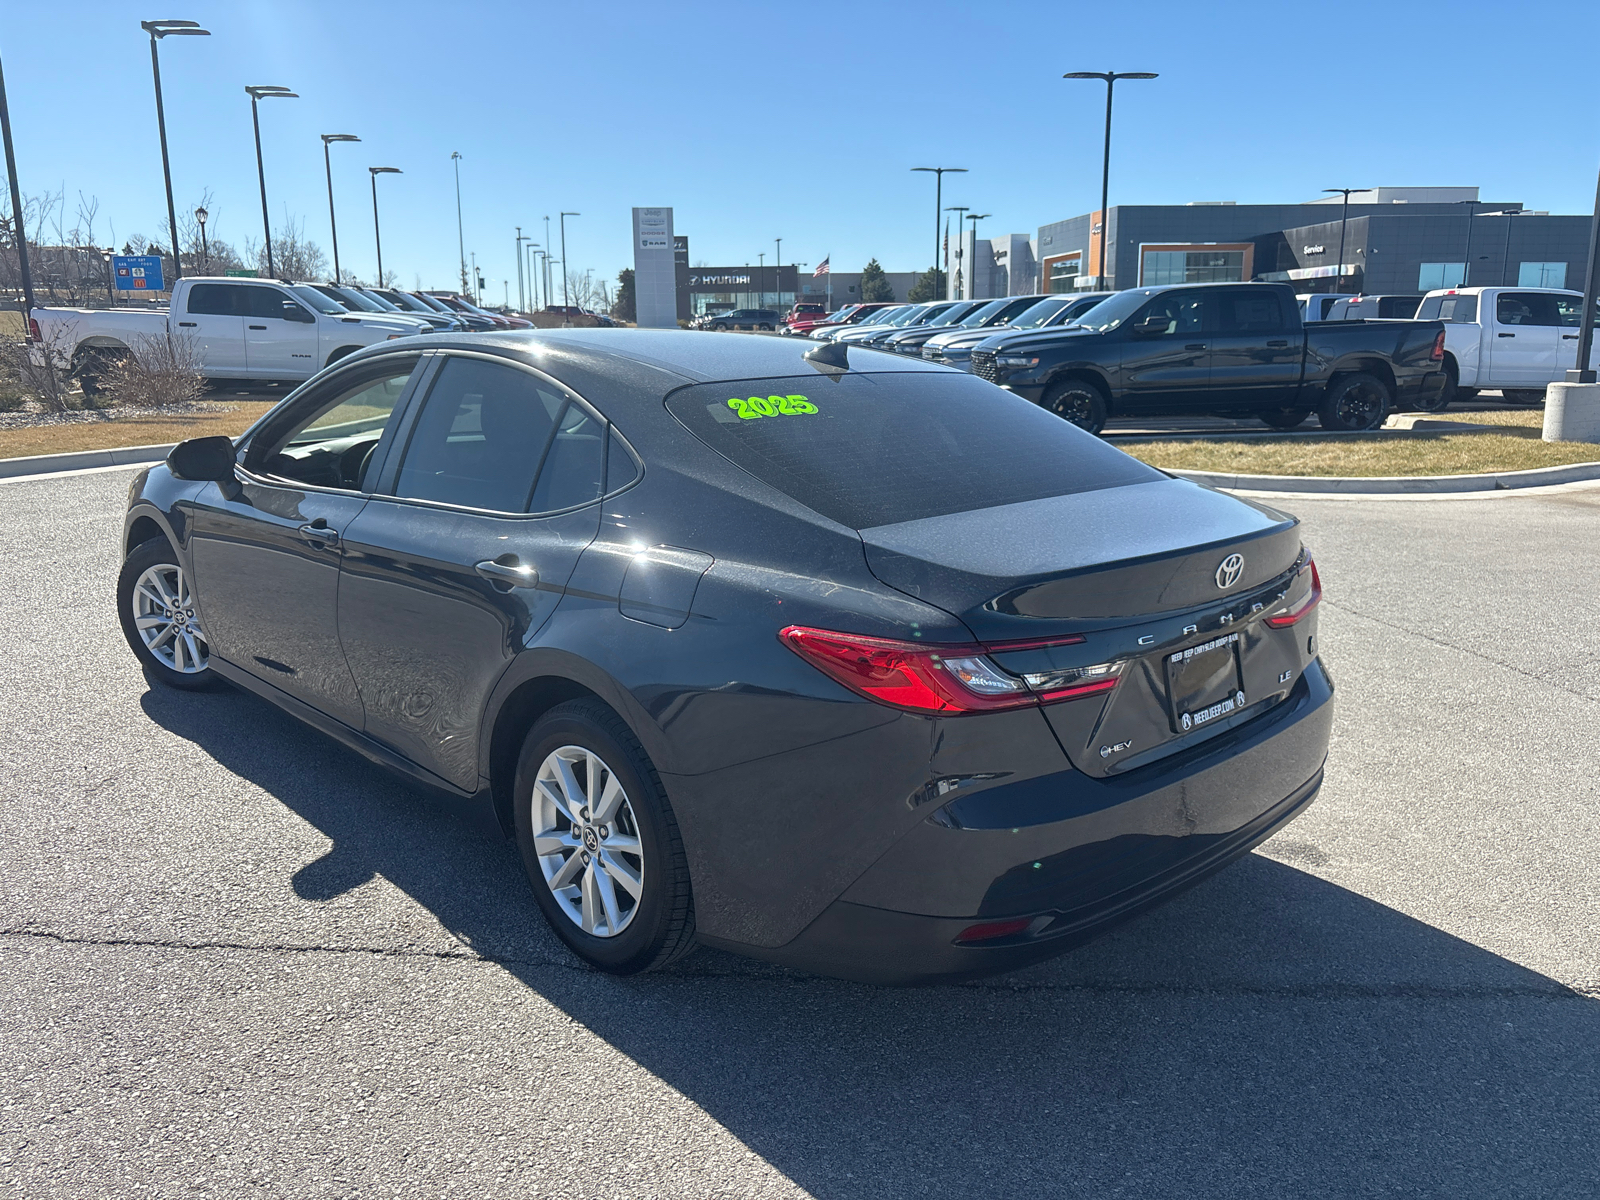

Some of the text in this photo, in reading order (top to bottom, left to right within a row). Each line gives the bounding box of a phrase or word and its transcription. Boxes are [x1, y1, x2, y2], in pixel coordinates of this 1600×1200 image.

[644, 209, 661, 217] Jeep
[1303, 244, 1324, 255] Service
[702, 275, 750, 285] HYUNDAI
[727, 394, 819, 420] 2025
[1171, 633, 1238, 663] REED JEEP CHRYSLER DODGE RAM
[1279, 670, 1291, 683] LE
[1193, 699, 1235, 725] REEDJEEP.COM
[1108, 740, 1132, 754] HEV
